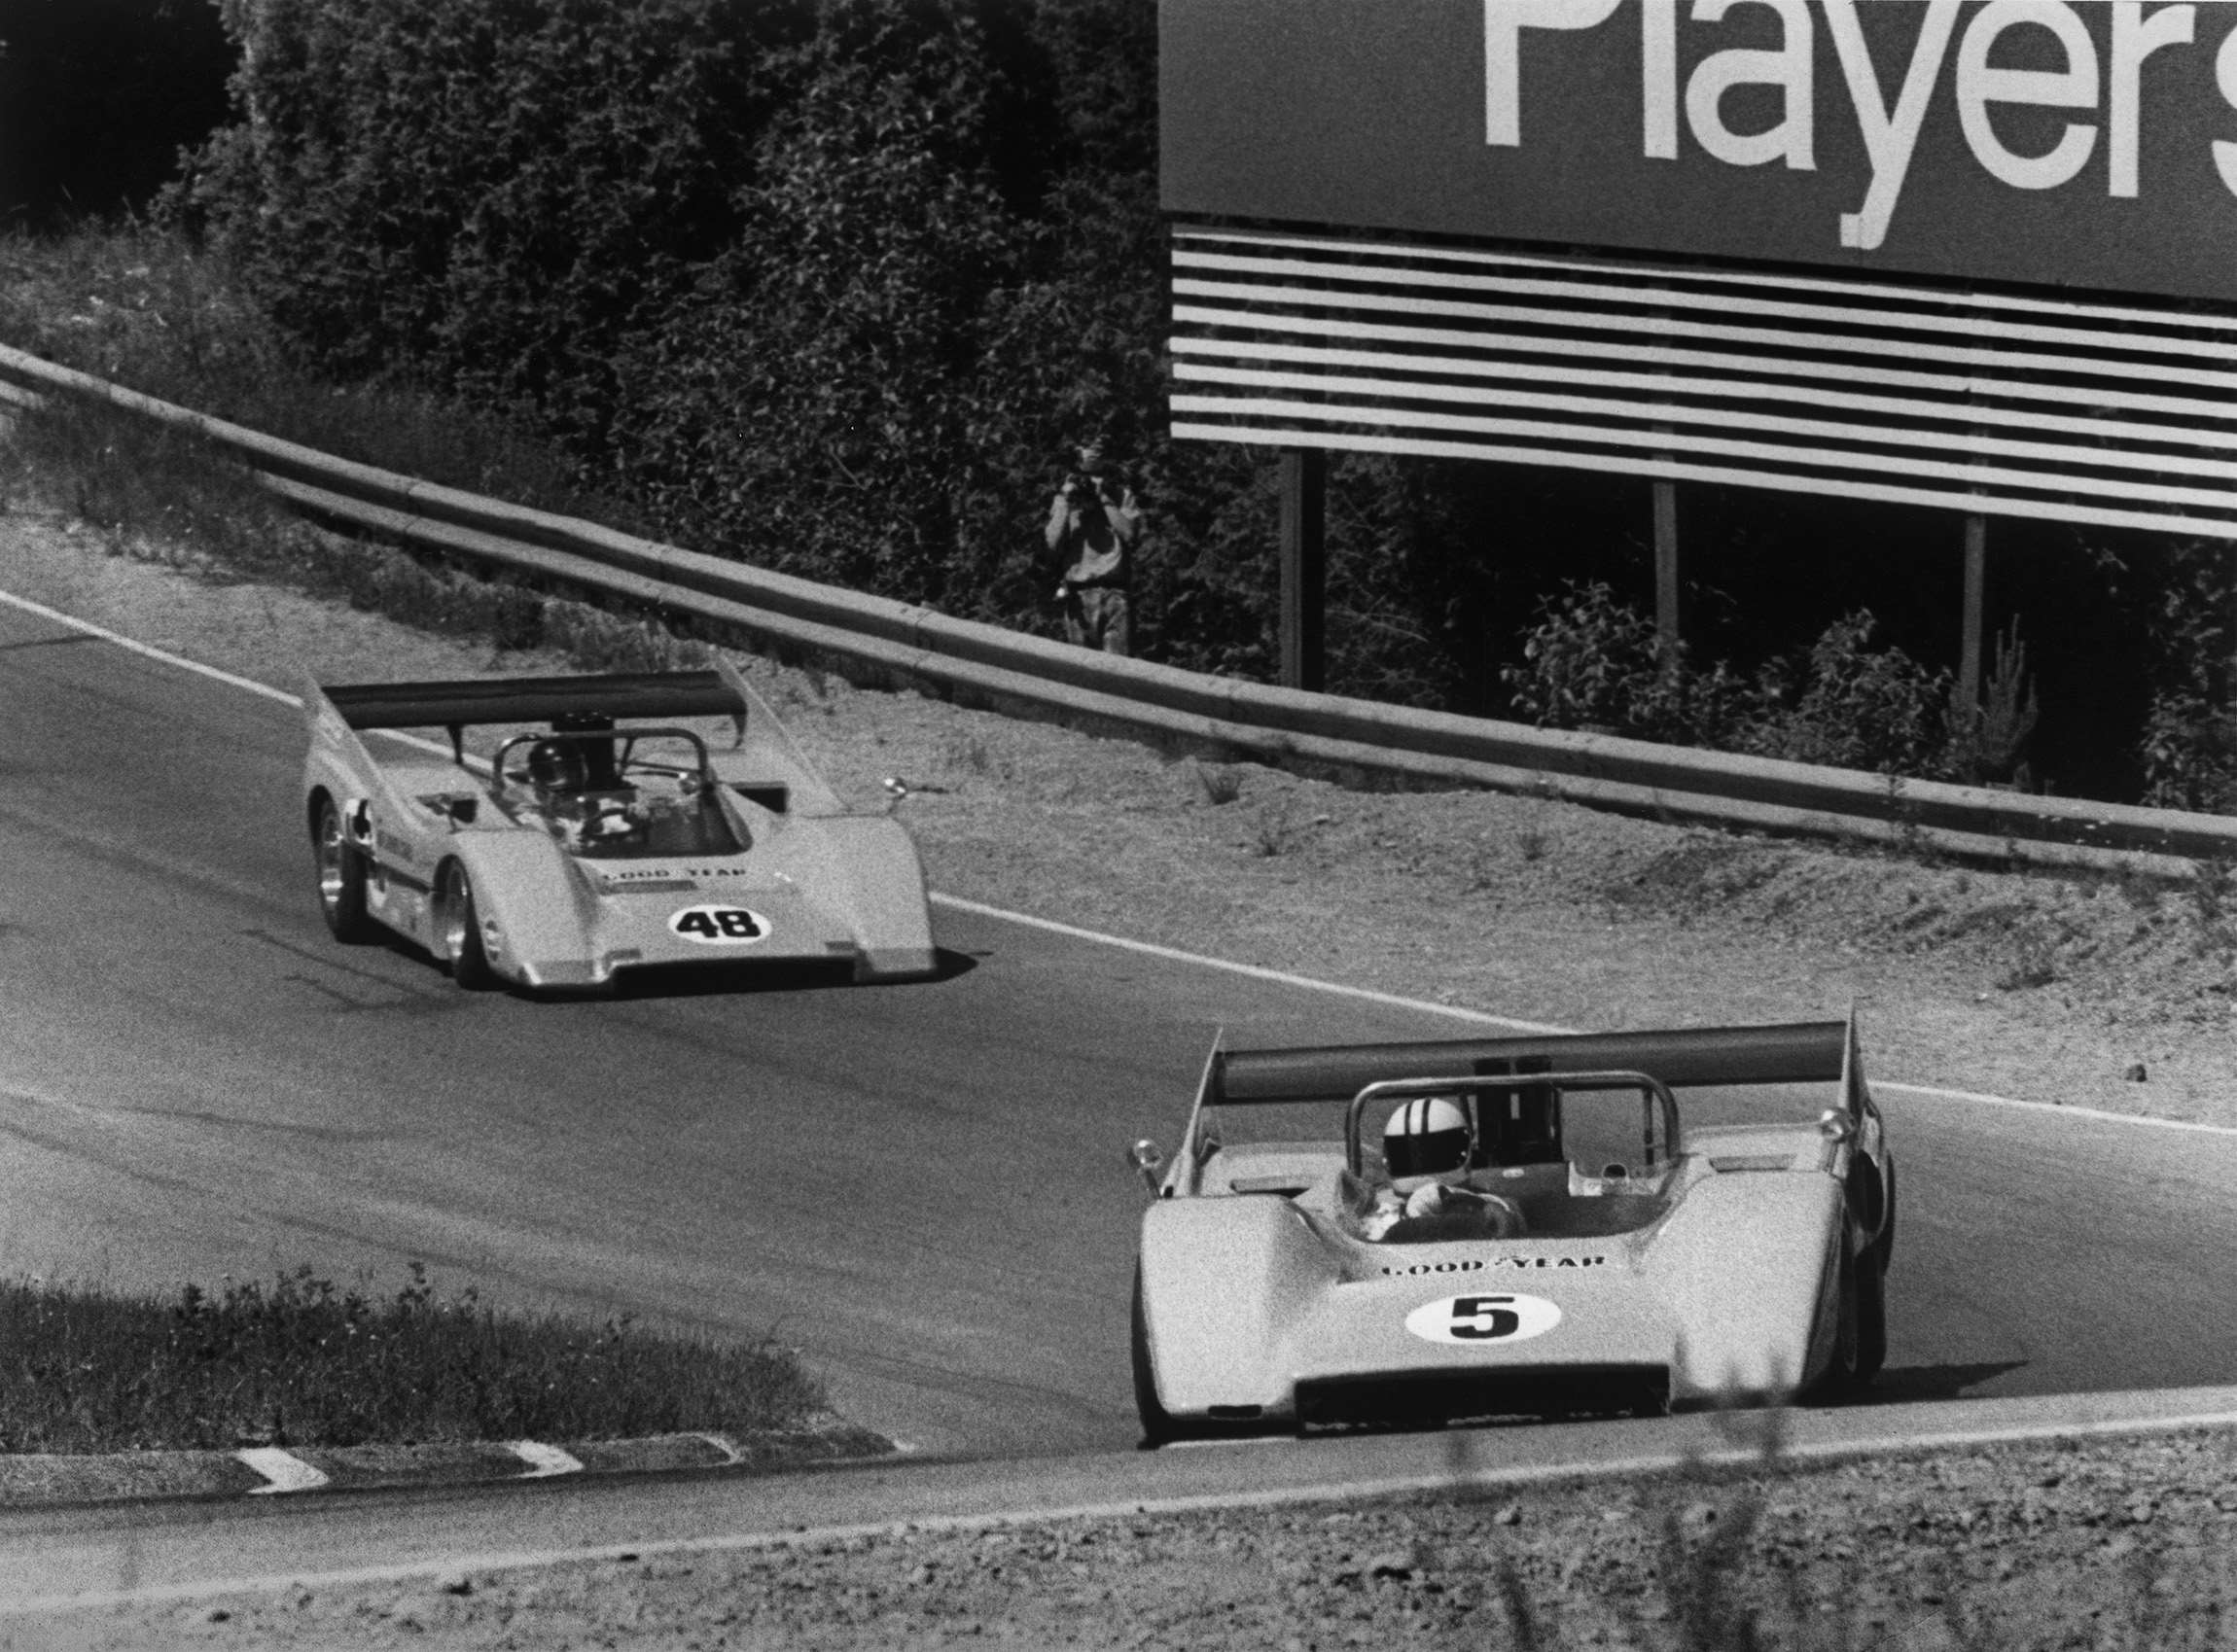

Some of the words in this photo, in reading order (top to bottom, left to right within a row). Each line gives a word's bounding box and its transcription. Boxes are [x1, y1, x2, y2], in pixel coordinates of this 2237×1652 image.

[1484, 0, 2237, 250] Player
[676, 910, 762, 938] 48
[1449, 1295, 1520, 1340] 5
